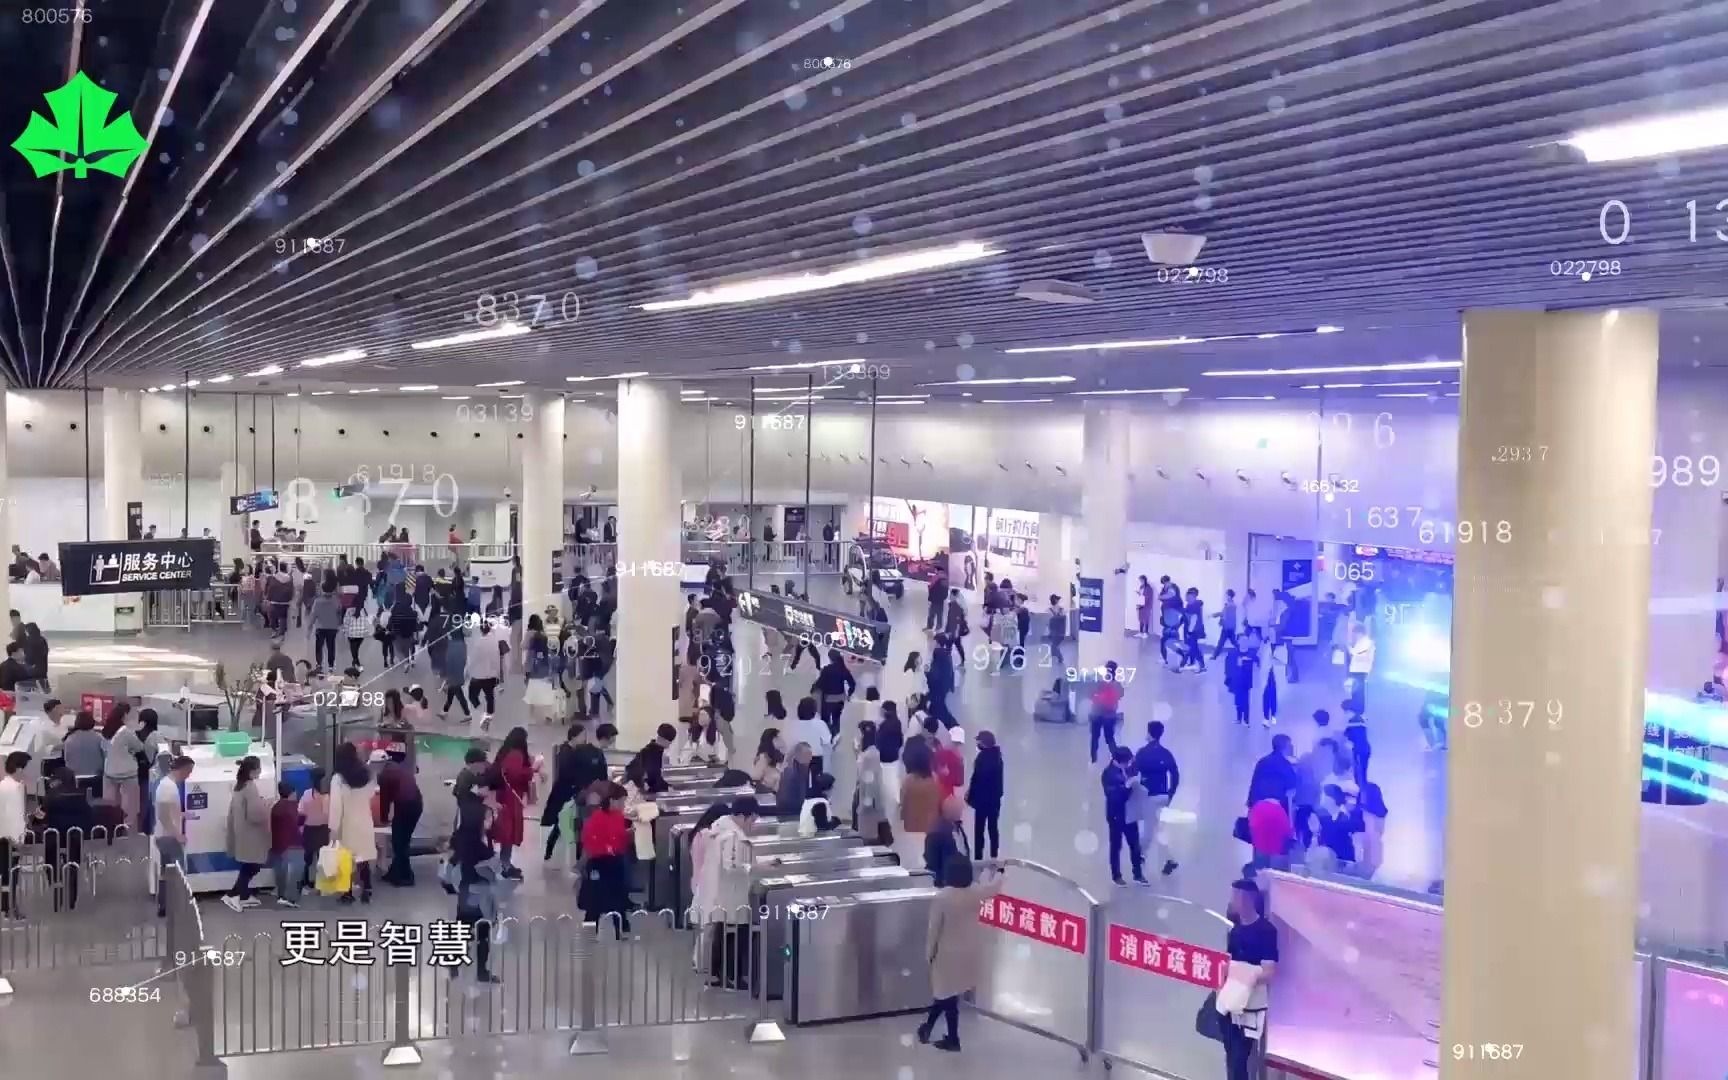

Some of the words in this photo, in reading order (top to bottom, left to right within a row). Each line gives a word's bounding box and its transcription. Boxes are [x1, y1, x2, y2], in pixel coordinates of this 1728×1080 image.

[123, 551, 194, 571] 服务中心
[121, 572, 159, 583] SERVICE
[159, 570, 193, 580] CENTER
[979, 898, 1080, 947] 消防疏散门
